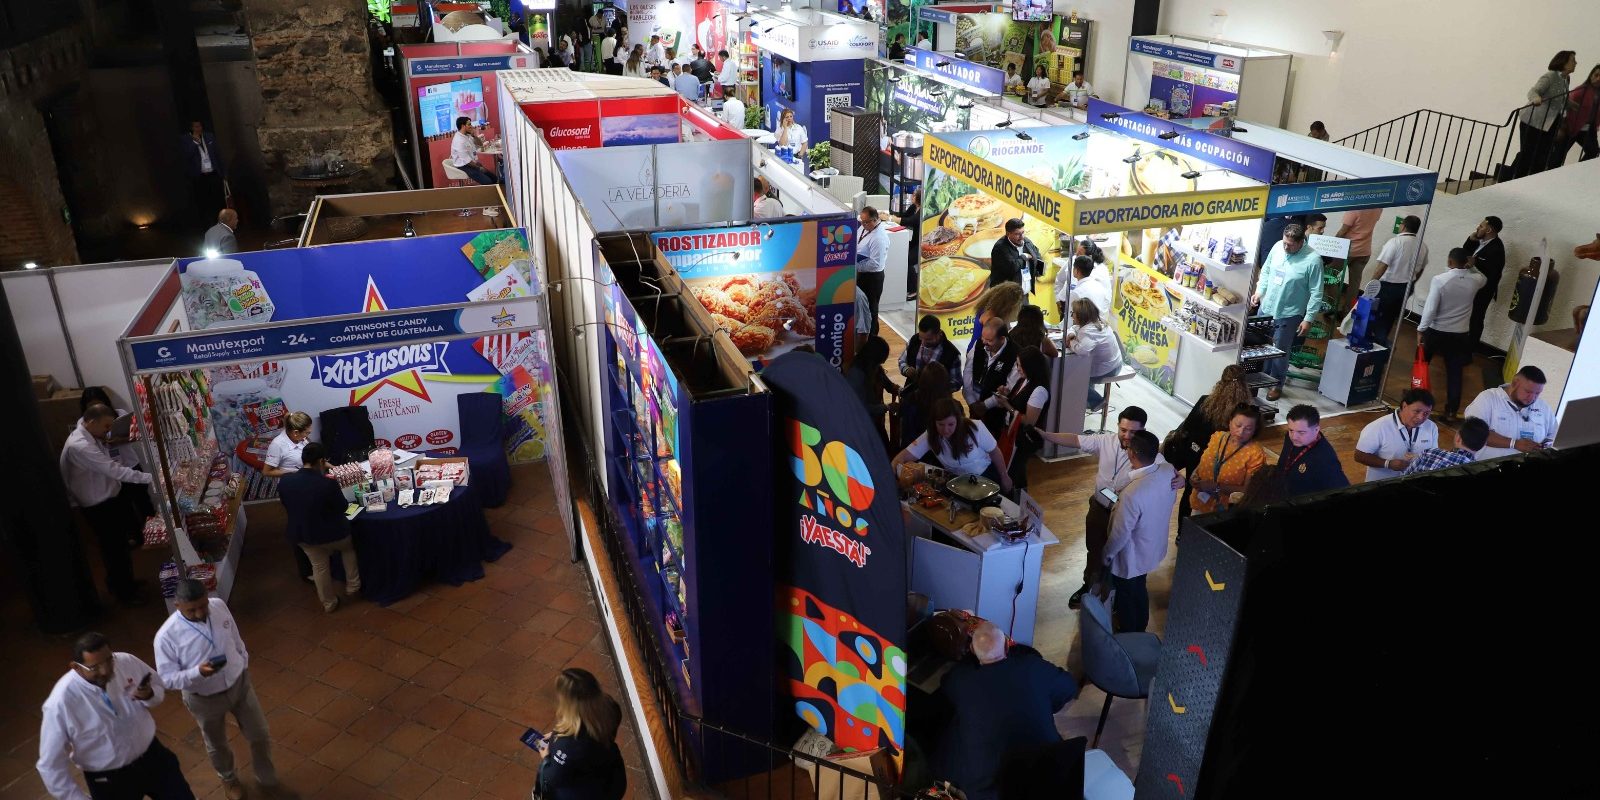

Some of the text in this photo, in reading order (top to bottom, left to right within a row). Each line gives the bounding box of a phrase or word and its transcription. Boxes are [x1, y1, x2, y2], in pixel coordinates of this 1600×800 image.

[925, 56, 935, 69] EL
[550, 124, 591, 138] Glucosoral
[991, 144, 1044, 157] RIOGRANDE
[1173, 133, 1192, 148] MÁS
[1195, 141, 1250, 167] OCUPACIÓN
[929, 143, 1062, 223] EXPORTADORA RIO GRANDE
[608, 184, 691, 202] LA VELADERIA
[1079, 197, 1260, 226] EXPORTADORA RIO GRANDE
[658, 231, 761, 252] ROSTIZADOR
[1123, 299, 1137, 319] DEL
[329, 324, 444, 343] COMPANY DE GUATEMALA
[343, 317, 428, 333] ATKINSON'S CANDY
[1118, 309, 1169, 348] A TU MESA
[186, 335, 266, 354] Manufexport
[367, 404, 422, 421] UALITY CANDY
[378, 397, 402, 409] FRESH
[798, 488, 869, 537] AÑOS
